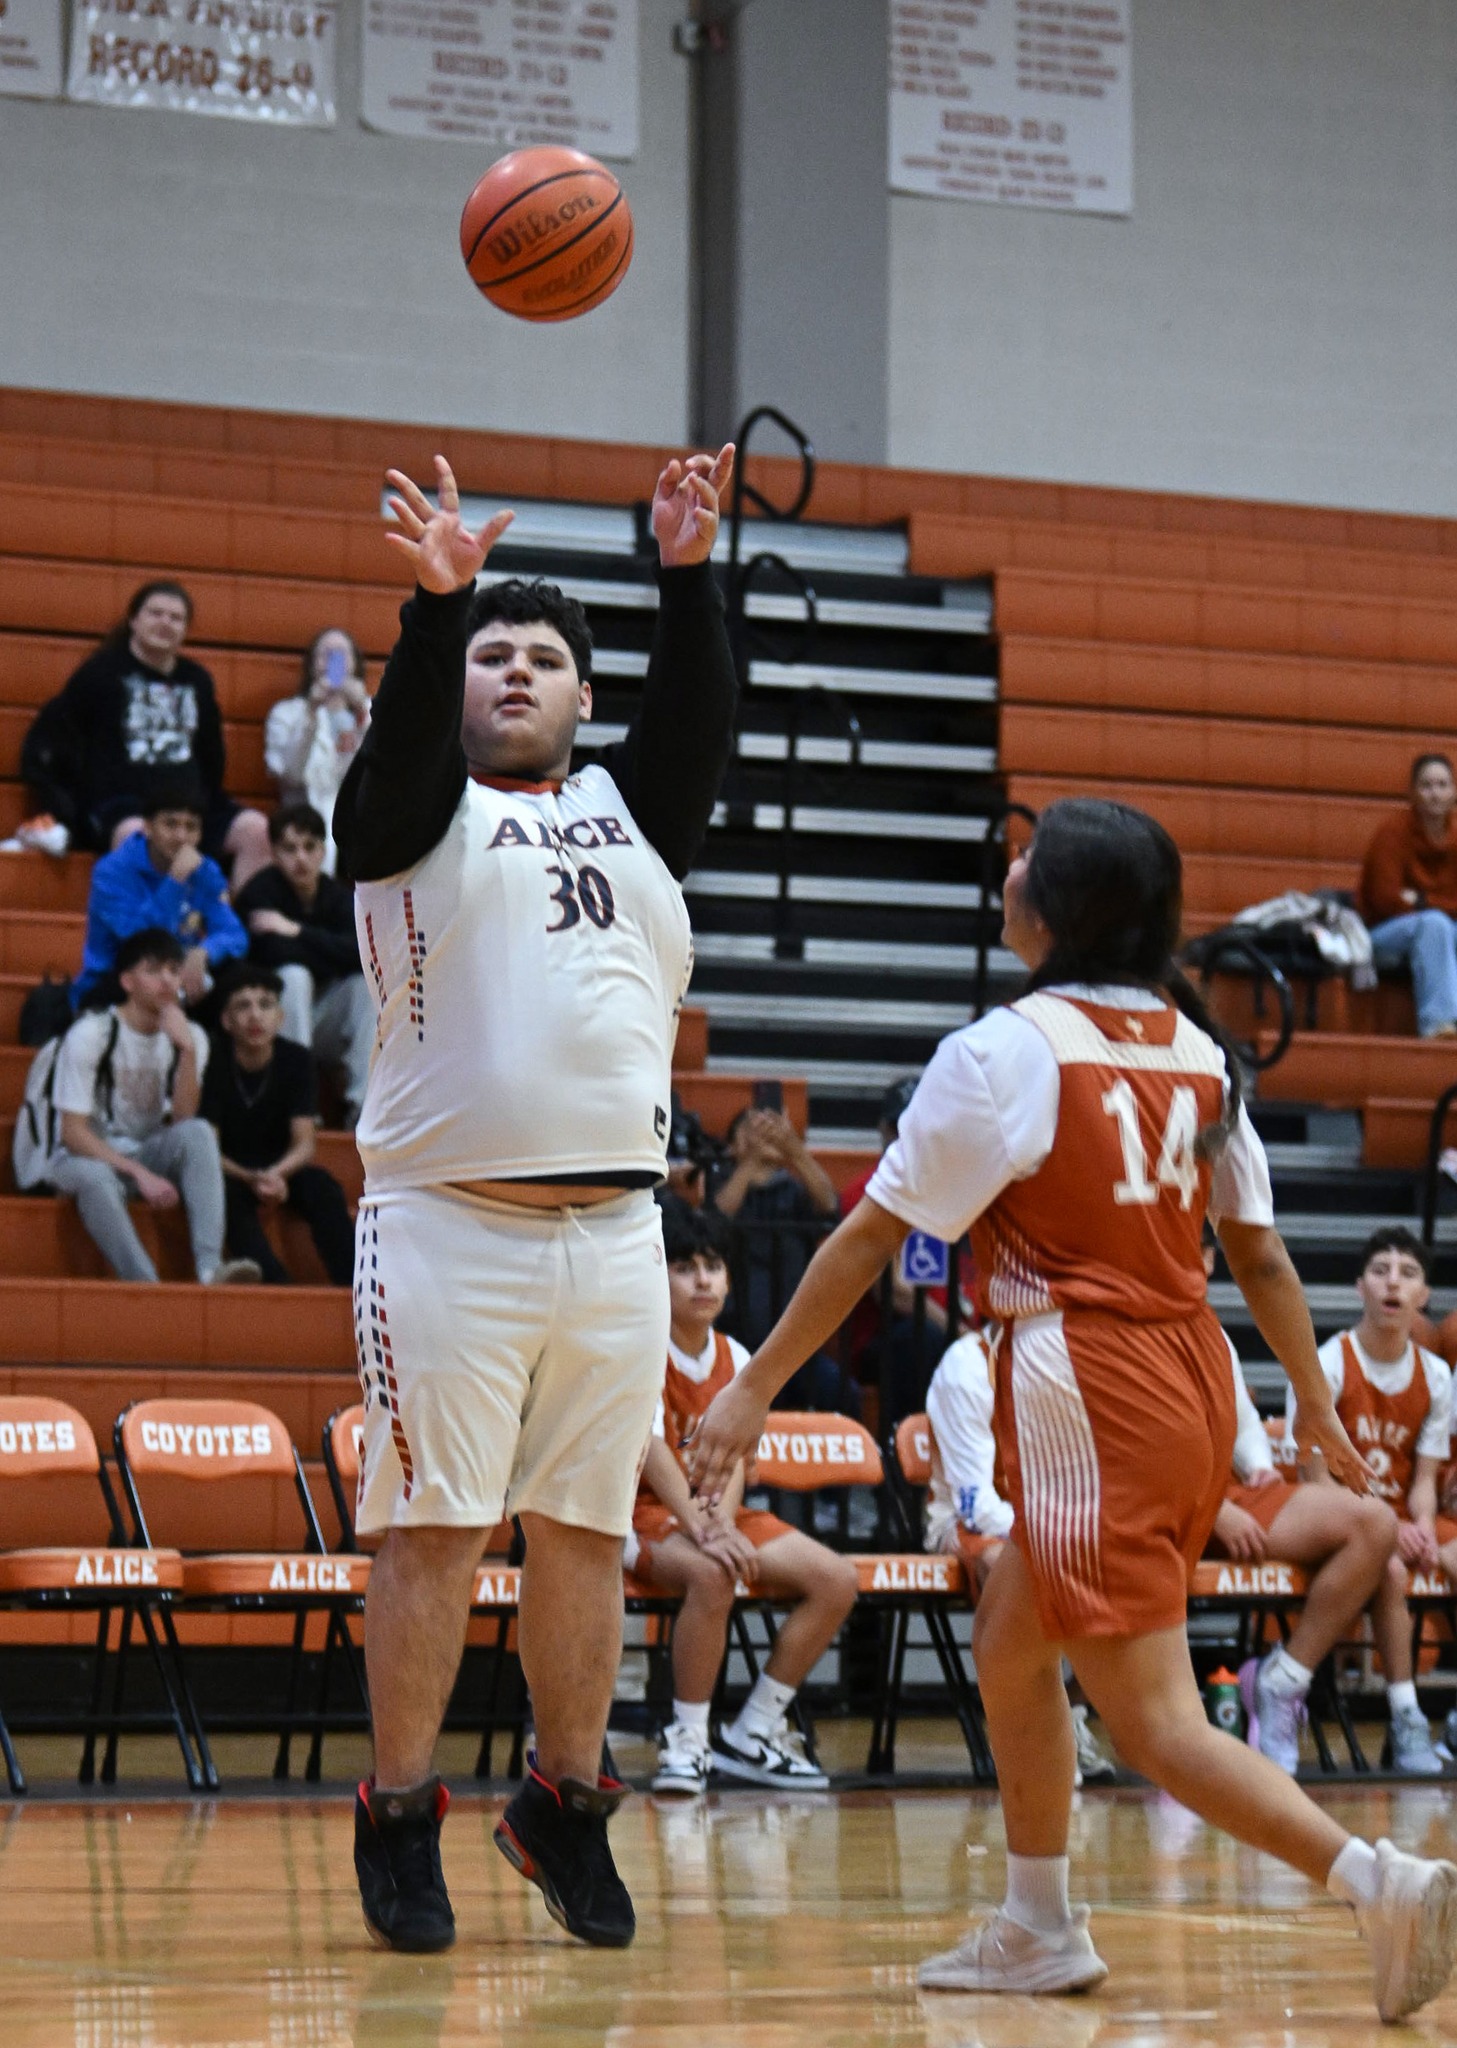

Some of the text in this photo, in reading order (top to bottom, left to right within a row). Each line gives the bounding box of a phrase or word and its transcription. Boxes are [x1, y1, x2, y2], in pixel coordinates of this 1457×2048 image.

[90, 34, 219, 88] RECORD
[486, 193, 598, 264] Wilson
[545, 866, 616, 933] 30
[1101, 1077, 1199, 1212] 14
[141, 1421, 273, 1457] COYOTES
[75, 1555, 159, 1585] ALICE
[269, 1562, 351, 1592] ALICE
[872, 1561, 949, 1591] ALICE
[1216, 1566, 1294, 1594] ALICE
